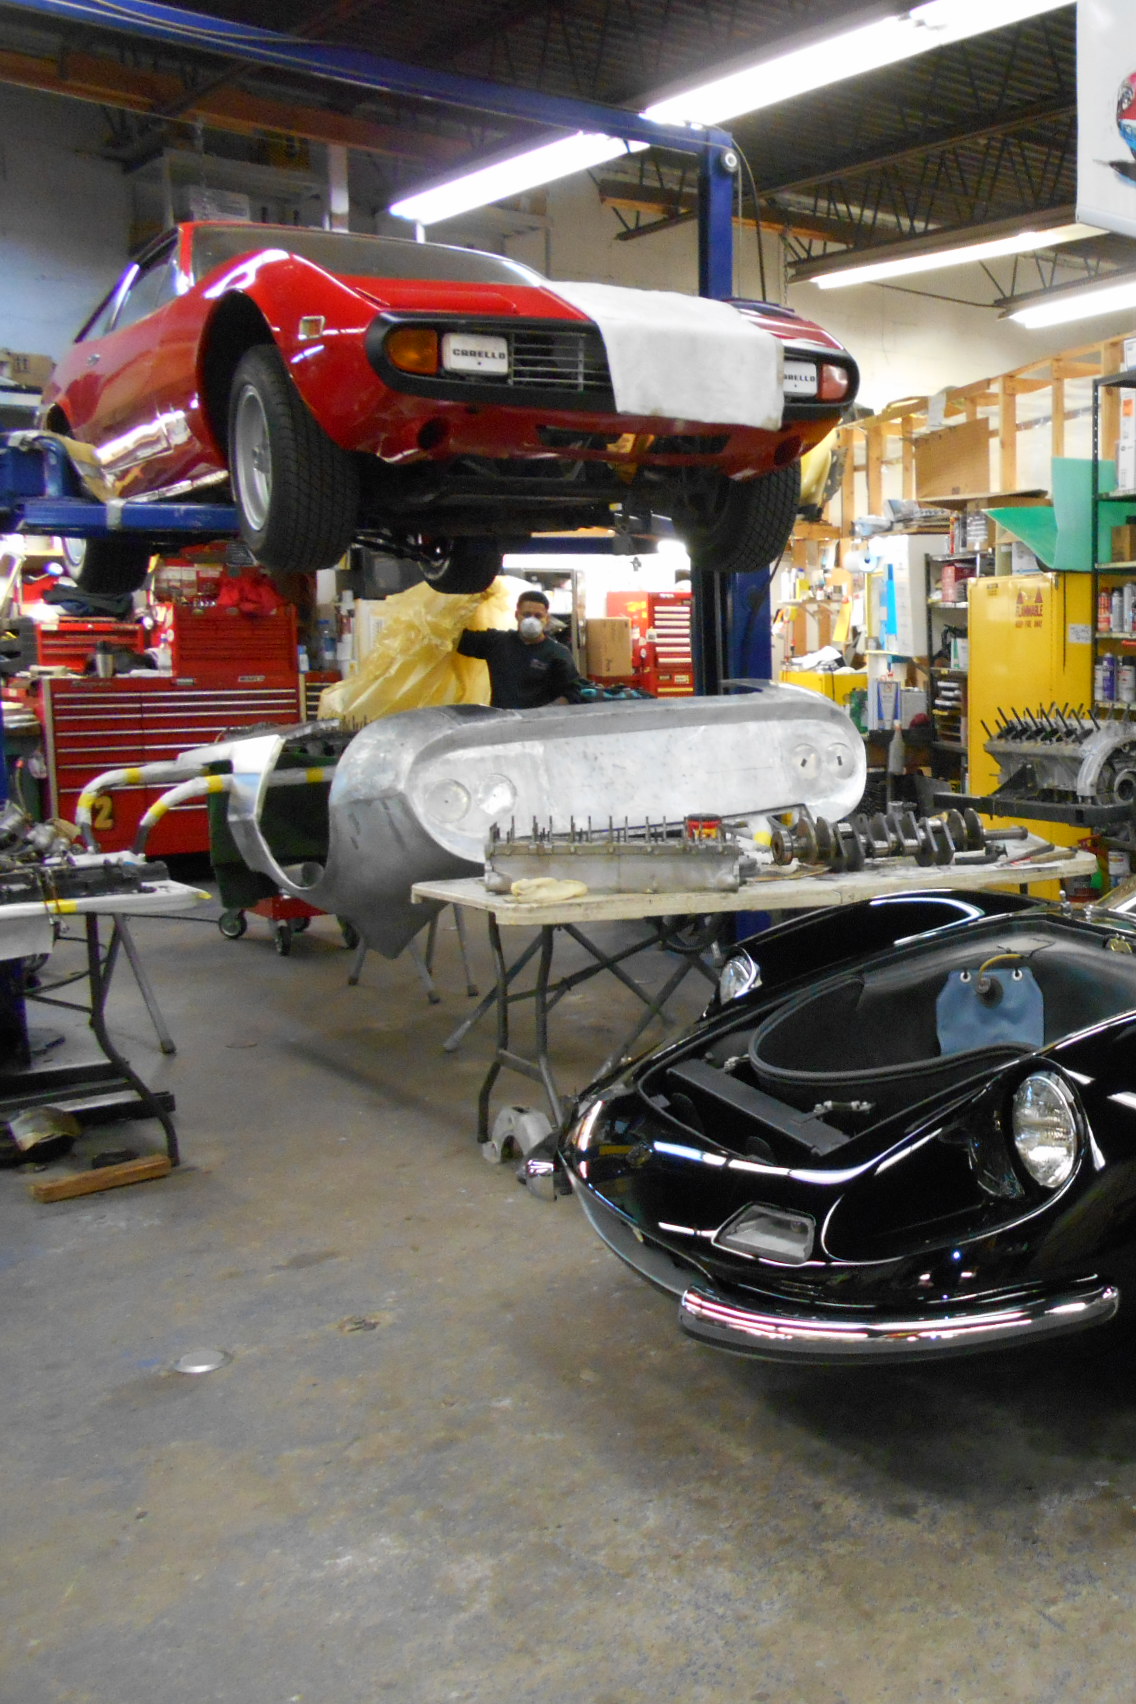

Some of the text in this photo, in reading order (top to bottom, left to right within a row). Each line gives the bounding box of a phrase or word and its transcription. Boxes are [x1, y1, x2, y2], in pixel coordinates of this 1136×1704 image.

[452, 348, 506, 360] CARELLO
[784, 373, 816, 382] ARELLO
[94, 796, 114, 830] 2
